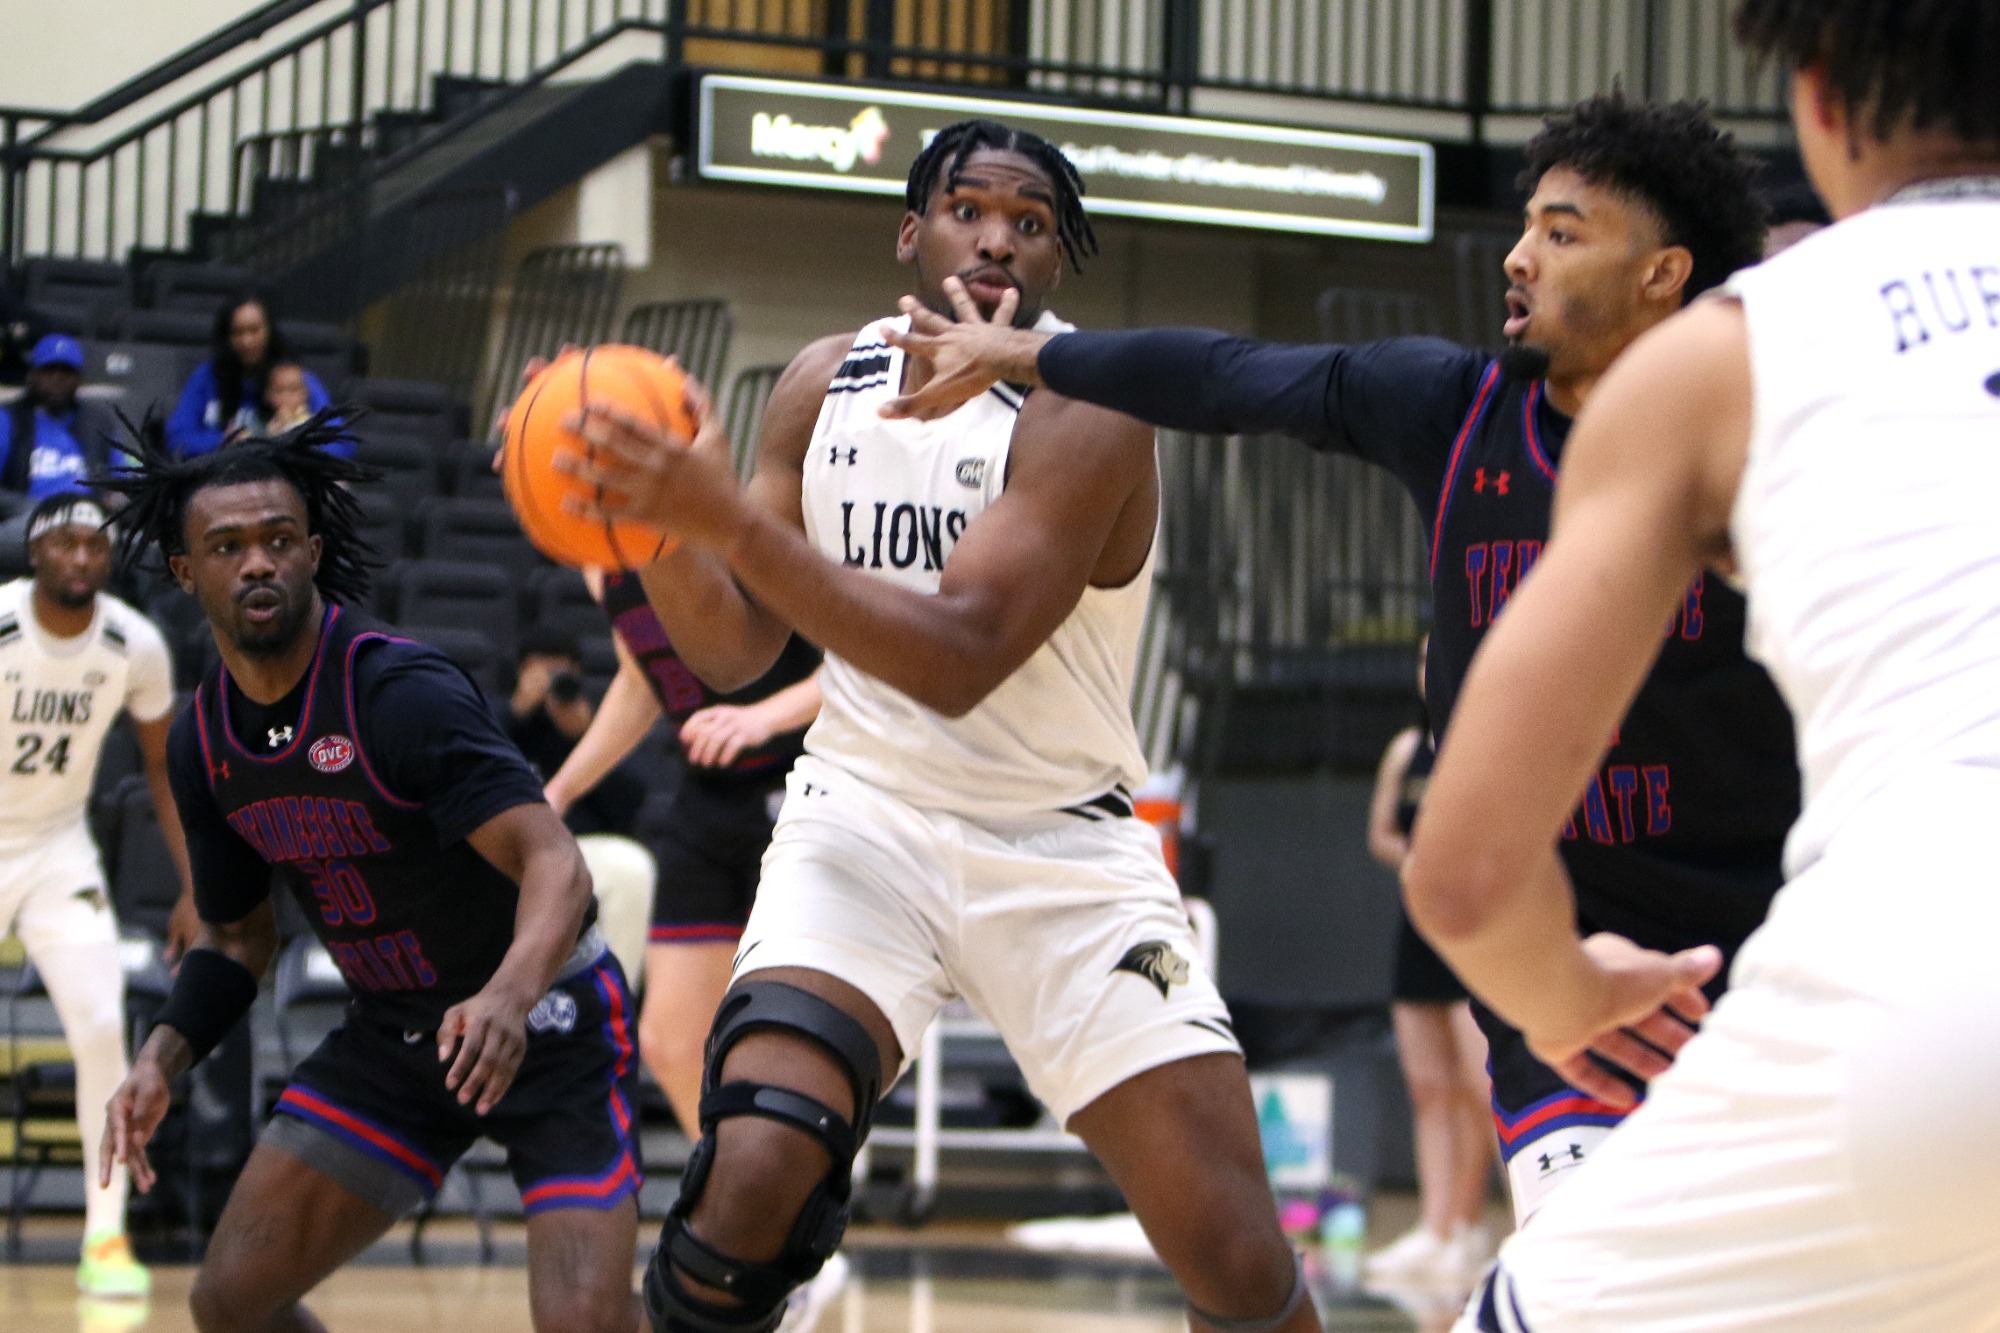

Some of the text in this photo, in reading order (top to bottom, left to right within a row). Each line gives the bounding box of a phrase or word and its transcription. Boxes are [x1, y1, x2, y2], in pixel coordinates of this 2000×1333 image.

[10, 688, 94, 725] LIONS
[11, 732, 71, 775] 24
[318, 745, 344, 764] OVC
[1562, 764, 1671, 844] ATE
[295, 857, 377, 926] 30
[327, 930, 437, 992] TATE
